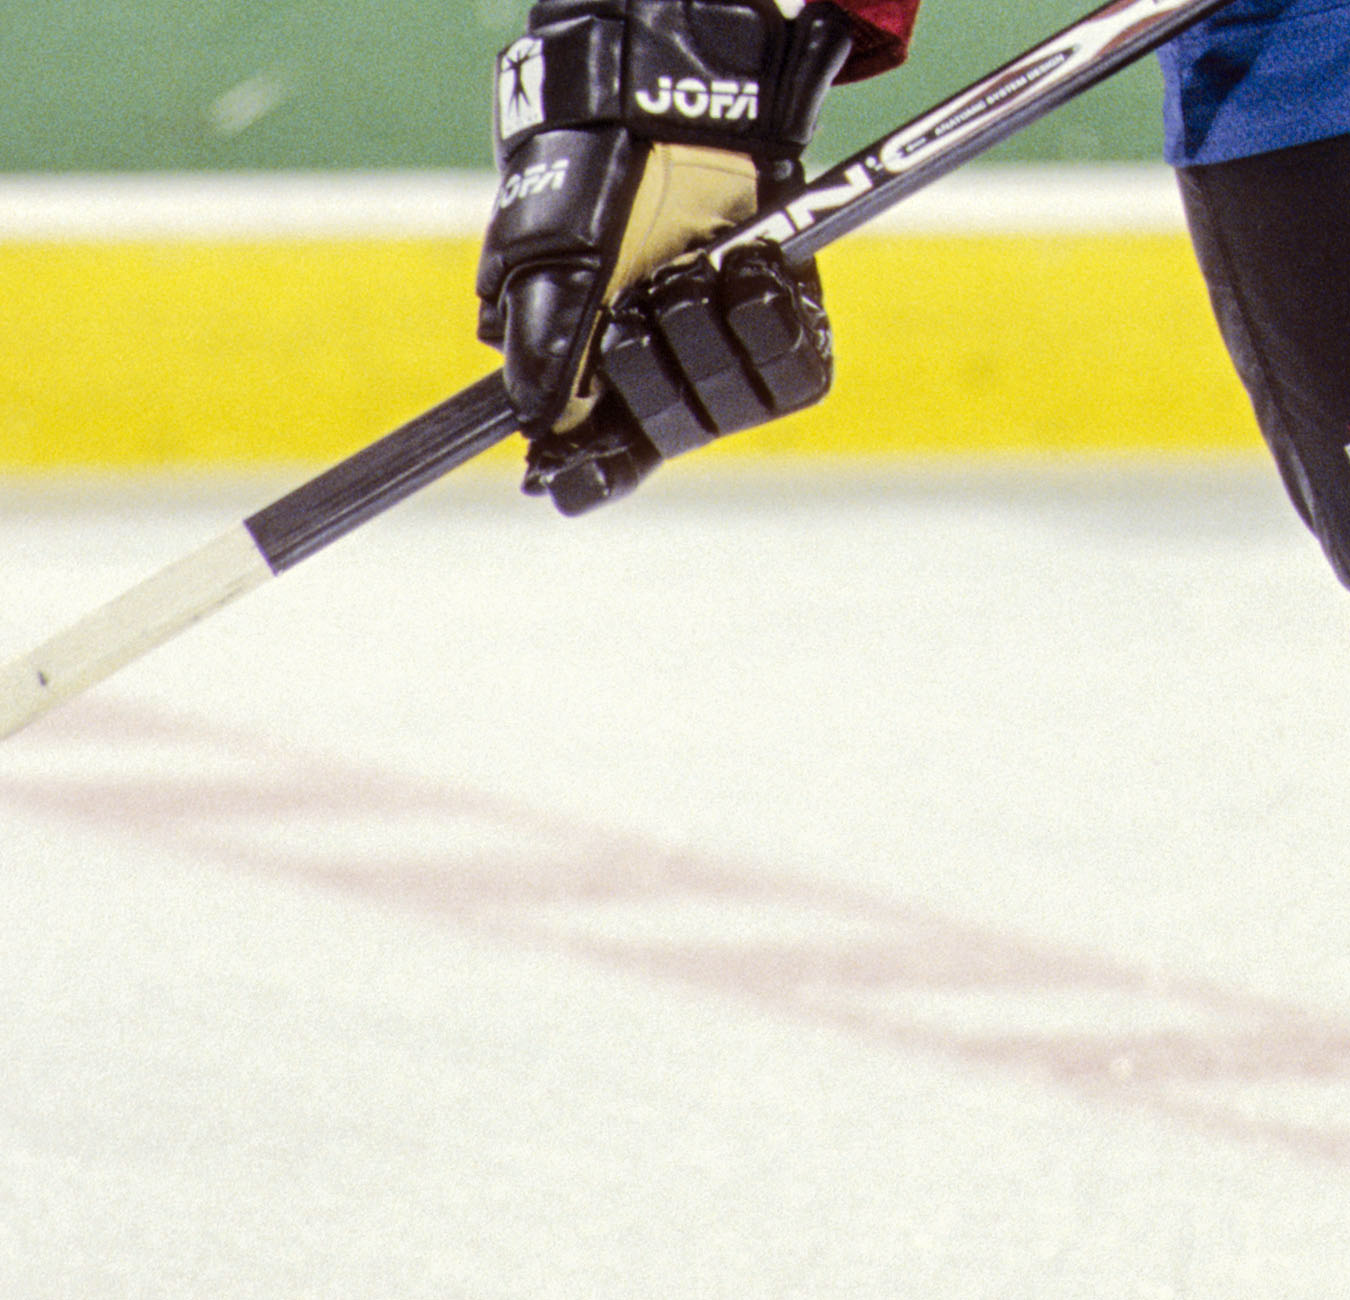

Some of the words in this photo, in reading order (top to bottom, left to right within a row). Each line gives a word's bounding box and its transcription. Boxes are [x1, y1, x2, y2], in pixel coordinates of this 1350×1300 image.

[634, 75, 759, 120] JOFA
[985, 74, 1027, 105] SYSTEM
[1025, 52, 1065, 81] DESIGN
[500, 158, 570, 209] OFA
